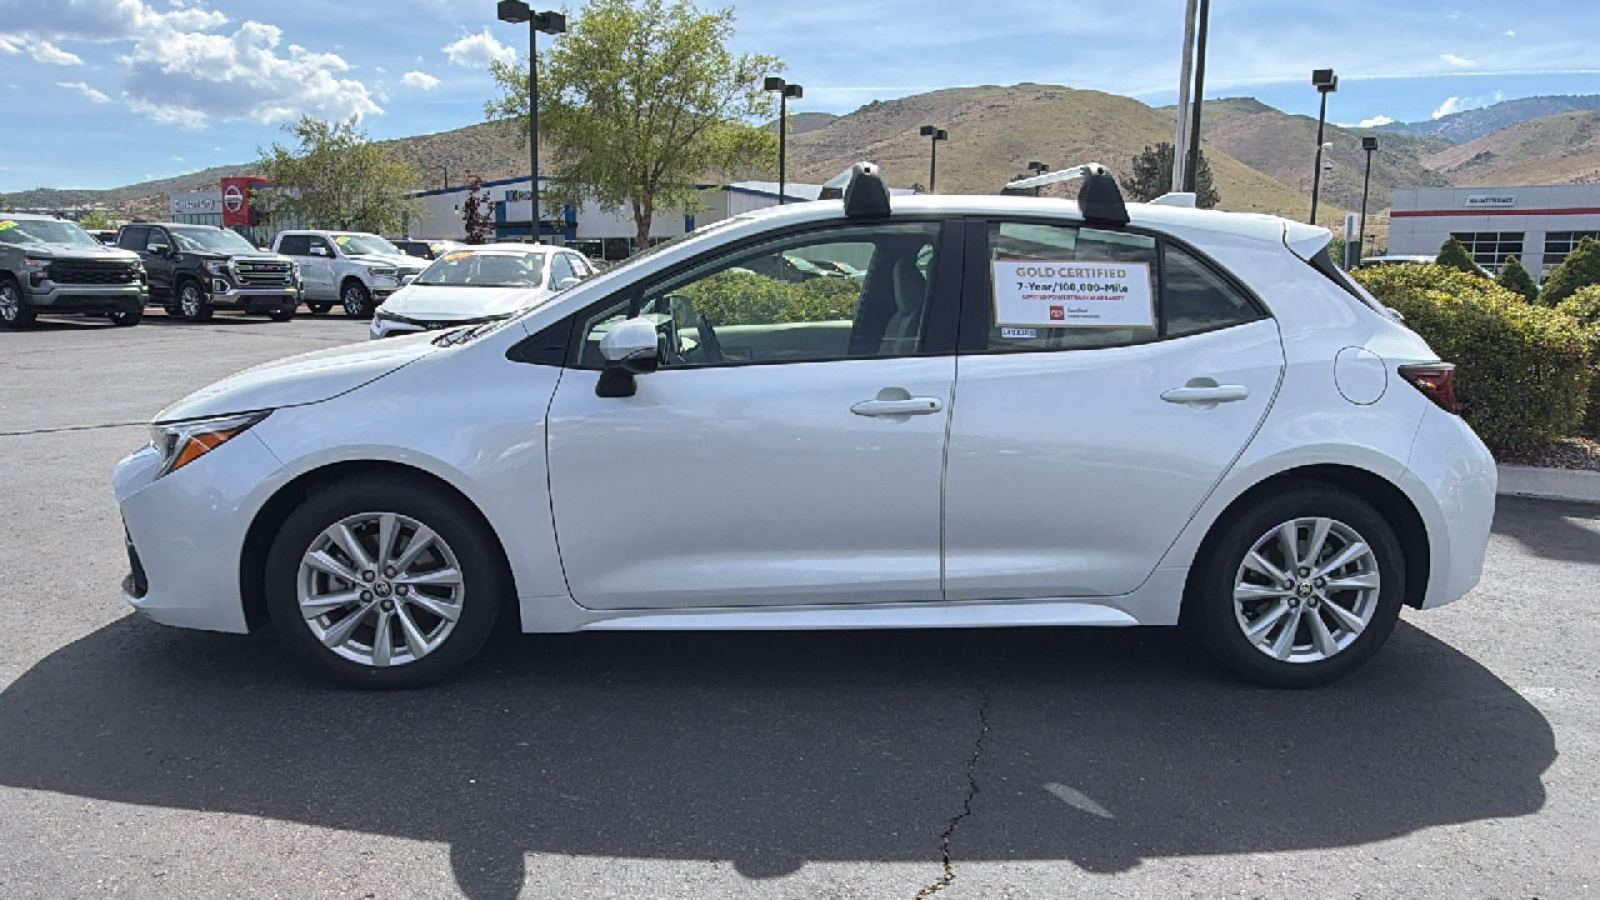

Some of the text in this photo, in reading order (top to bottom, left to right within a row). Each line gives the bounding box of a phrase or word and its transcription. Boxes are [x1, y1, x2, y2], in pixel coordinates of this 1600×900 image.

[1015, 267, 1127, 279] GOLD CERTIFIED
[1016, 282, 1129, 293] 7-Year/100,000-Mile
